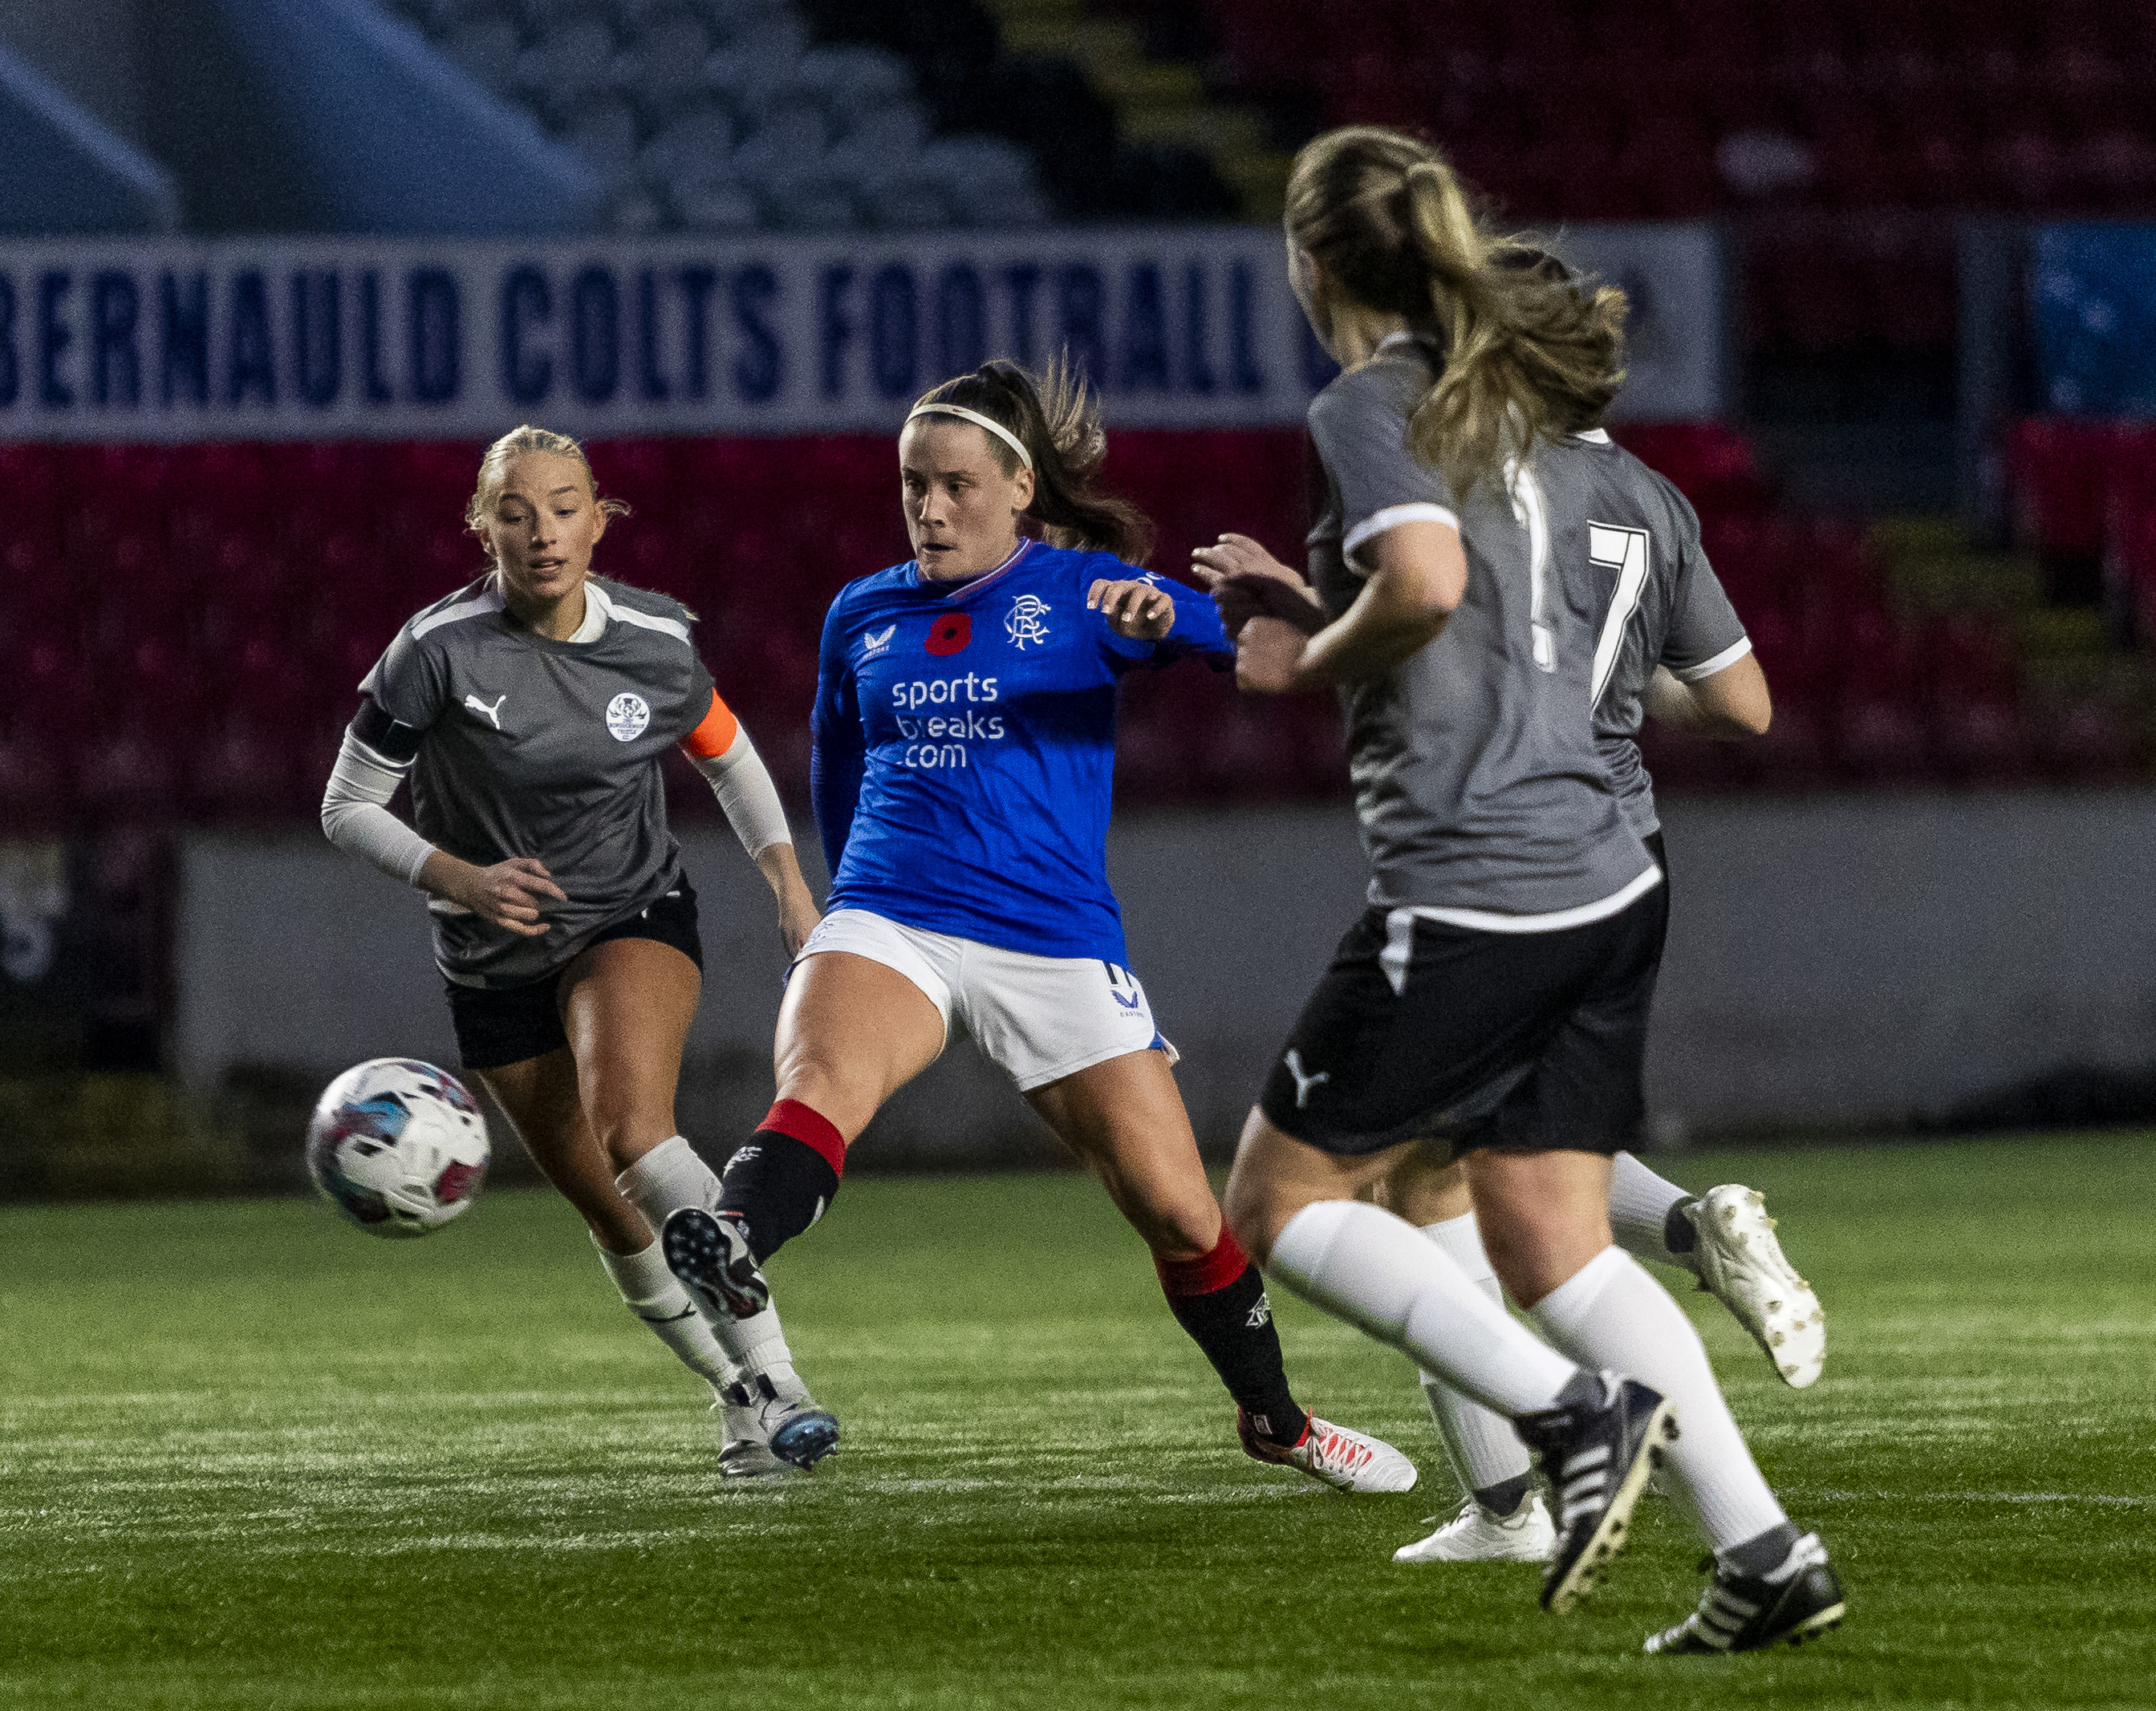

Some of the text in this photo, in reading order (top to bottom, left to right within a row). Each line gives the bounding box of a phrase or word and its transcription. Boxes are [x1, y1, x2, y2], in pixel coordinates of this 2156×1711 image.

[501, 261, 785, 405] COLTS
[818, 259, 1264, 399] FOOTBALL
[1586, 518, 1650, 721] 7
[891, 671, 998, 710] sports
[895, 744, 967, 768] .com
